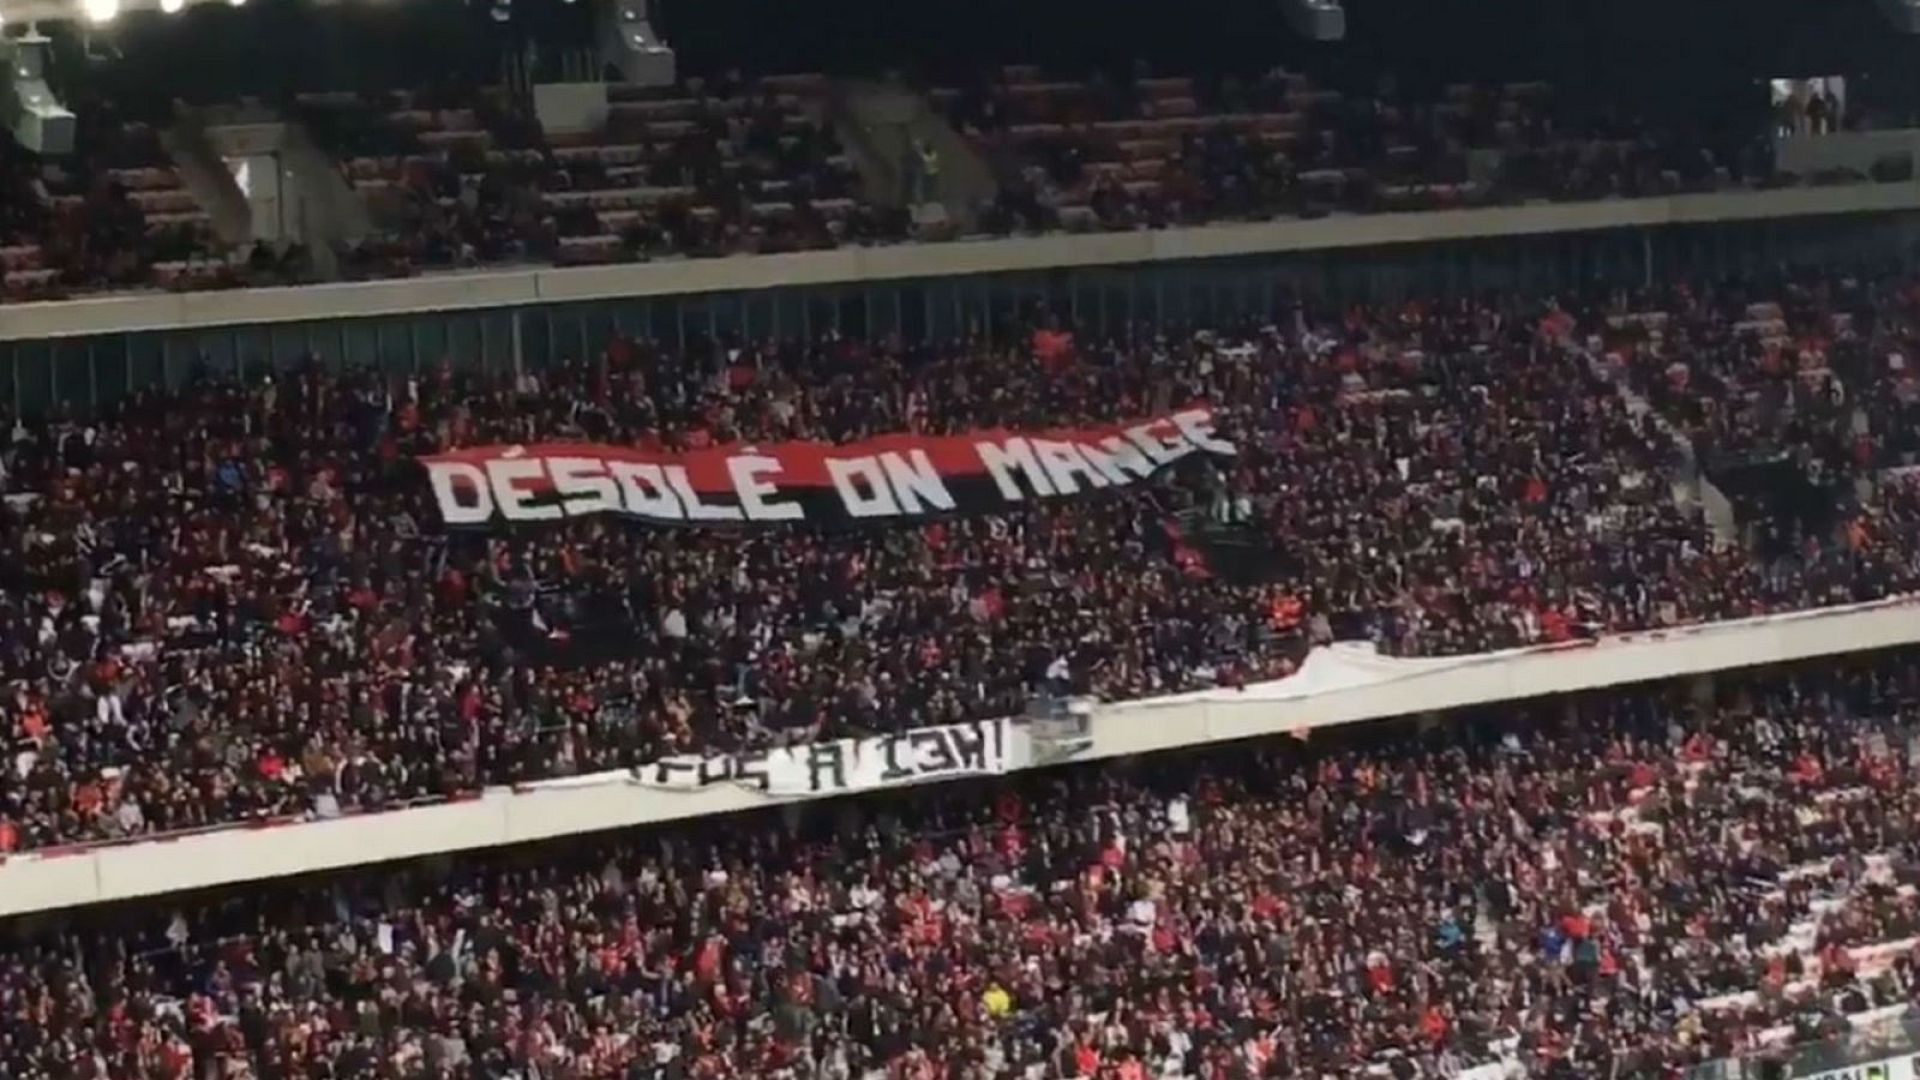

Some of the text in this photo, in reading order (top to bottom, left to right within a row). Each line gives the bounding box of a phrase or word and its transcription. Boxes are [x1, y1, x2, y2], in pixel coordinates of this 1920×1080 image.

[426, 408, 1238, 524] DÉSOLÉ ON MANGE
